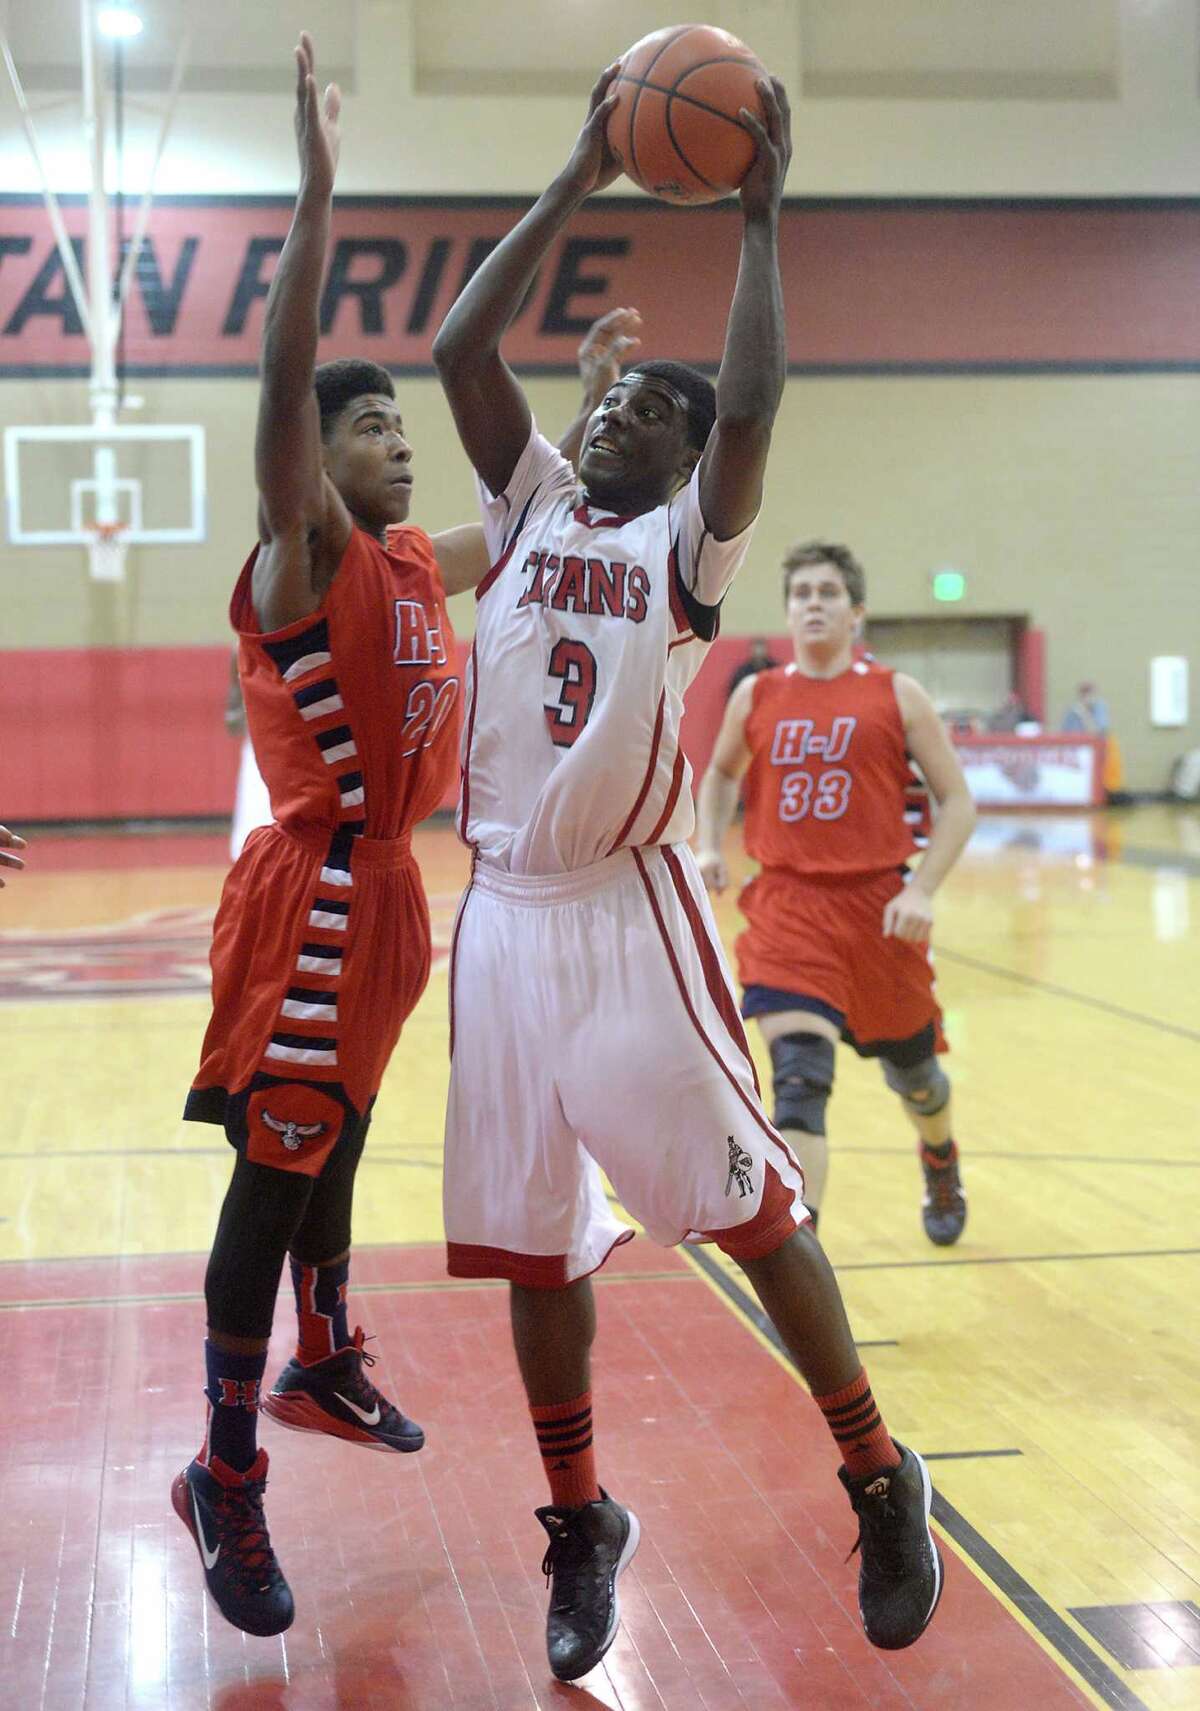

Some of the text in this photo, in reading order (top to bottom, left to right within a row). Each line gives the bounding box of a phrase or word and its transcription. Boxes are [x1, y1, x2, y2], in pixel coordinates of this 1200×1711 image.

[222, 236, 630, 335] PRIE
[400, 677, 459, 758] 20
[543, 637, 597, 748] 3
[770, 716, 857, 766] H-J
[778, 769, 852, 823] 33
